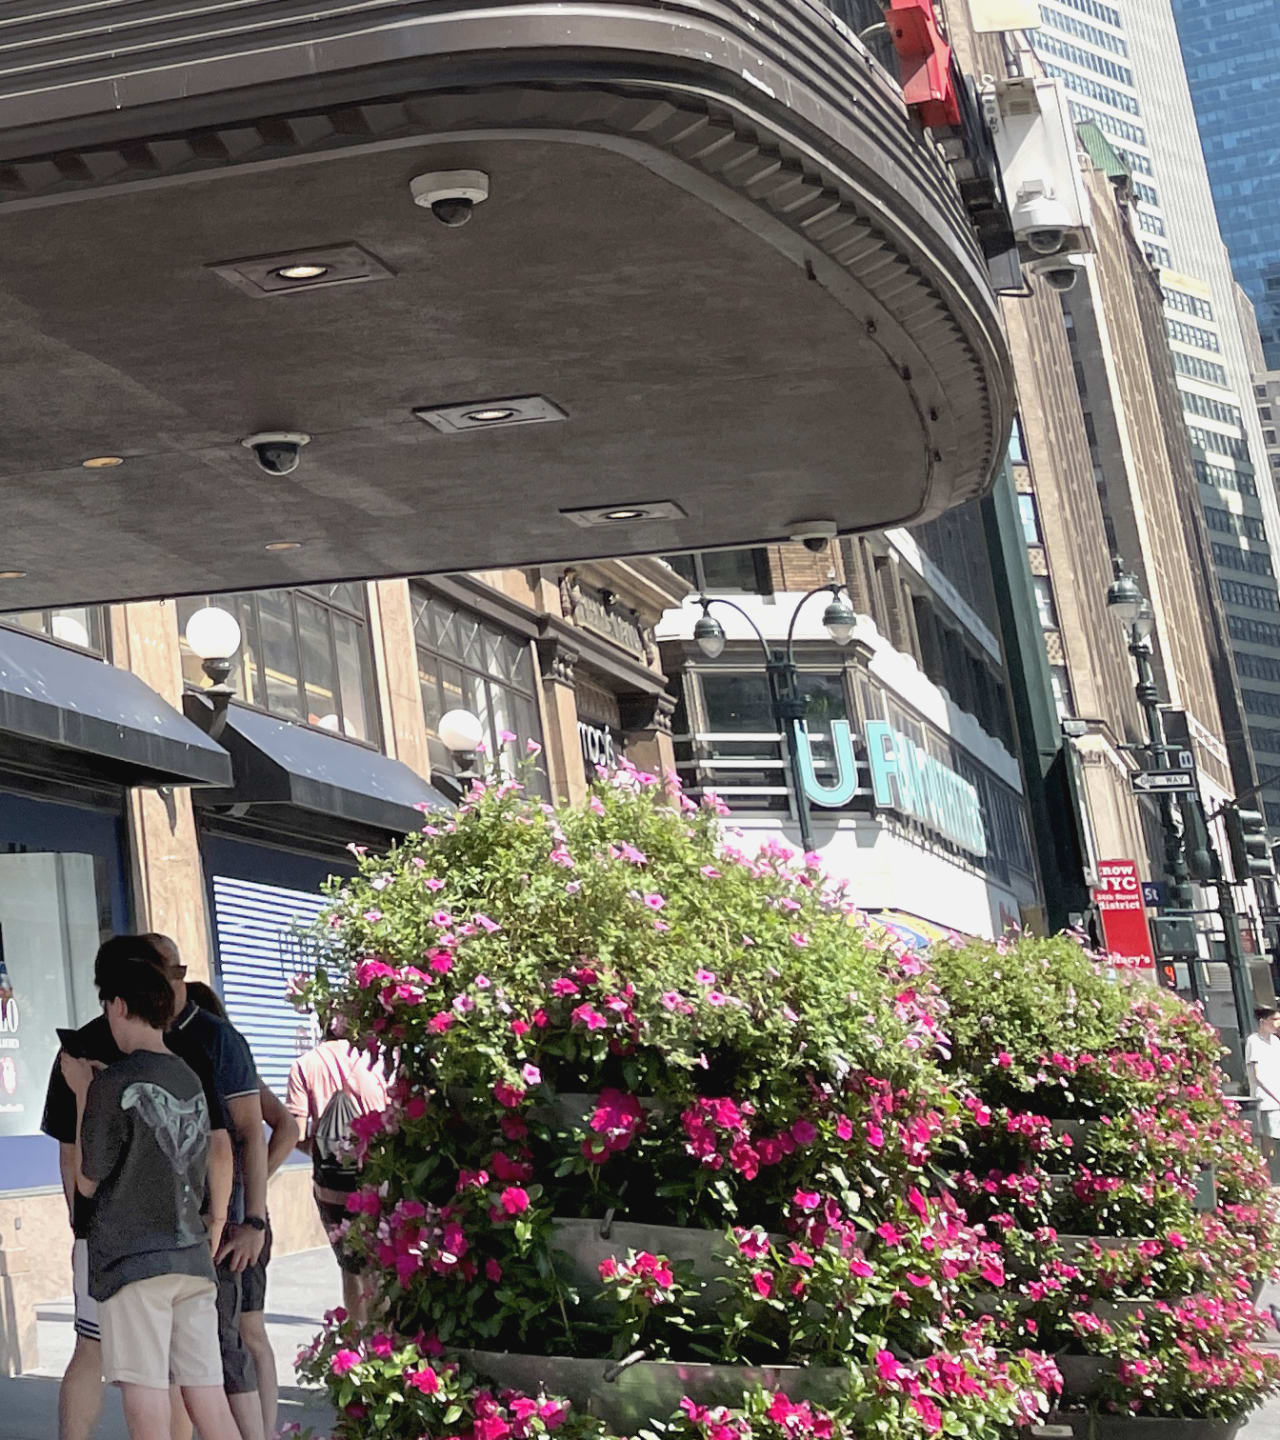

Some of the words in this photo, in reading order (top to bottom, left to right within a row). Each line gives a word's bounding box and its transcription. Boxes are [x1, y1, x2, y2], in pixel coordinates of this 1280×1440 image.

[1140, 776, 1157, 785] ONE
[1165, 776, 1185, 784] WAY
[1099, 866, 1133, 876] now
[1145, 888, 1159, 901] St
